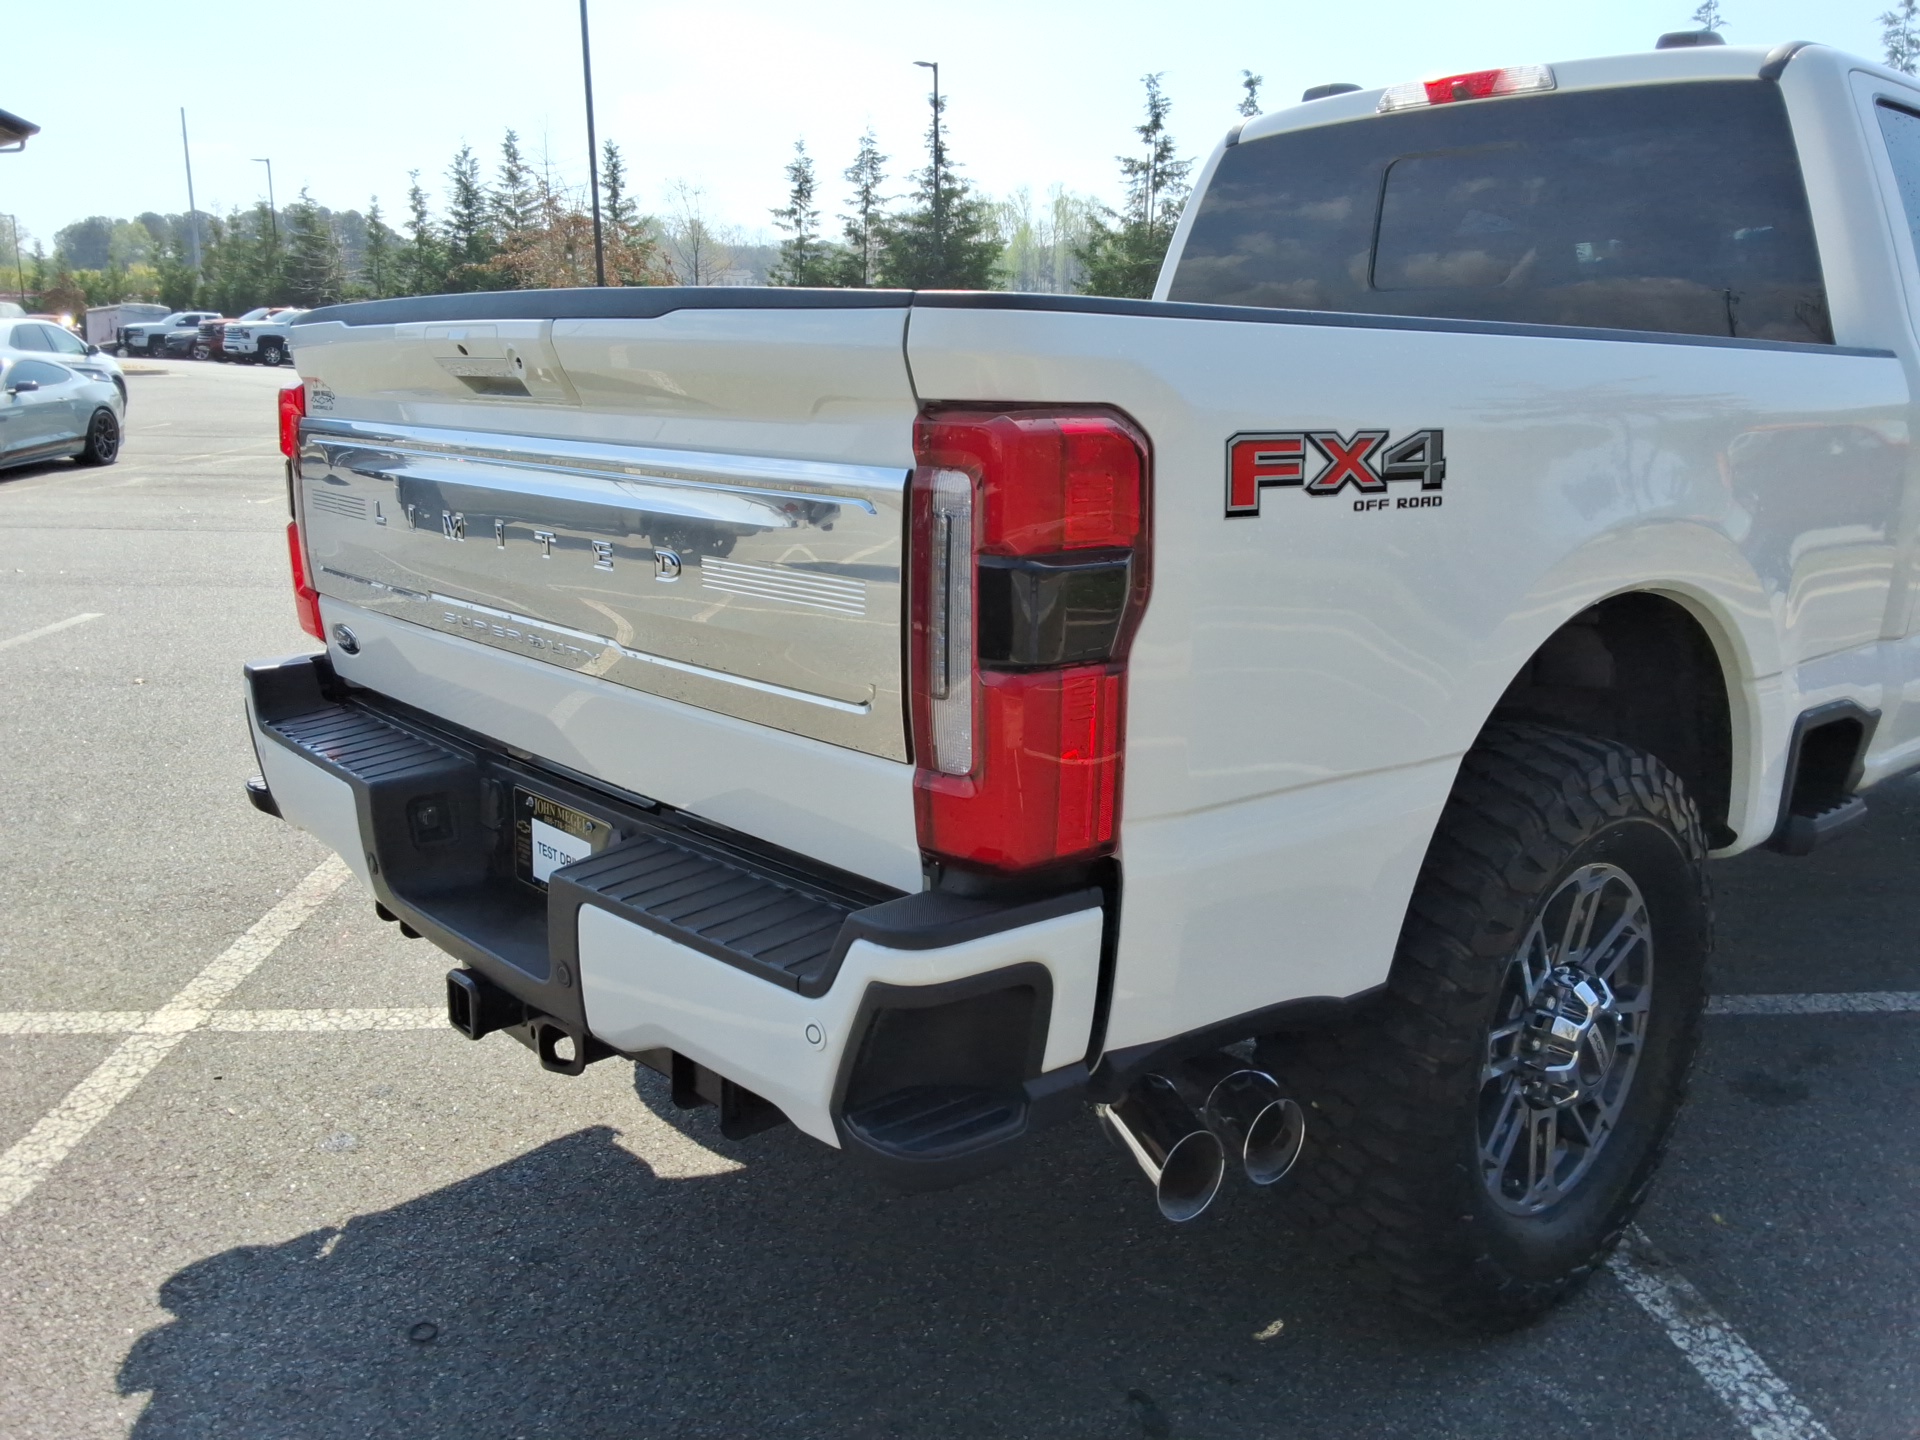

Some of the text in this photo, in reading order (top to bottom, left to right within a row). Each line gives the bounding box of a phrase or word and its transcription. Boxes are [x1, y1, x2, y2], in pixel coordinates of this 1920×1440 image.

[1224, 428, 1446, 520] FX4
[1353, 495, 1443, 512] OFF ROAD
[372, 499, 682, 583] LIMITED
[443, 611, 601, 664] SUPER DUTY
[533, 797, 556, 816] JOHN
[537, 840, 558, 862] TEST
